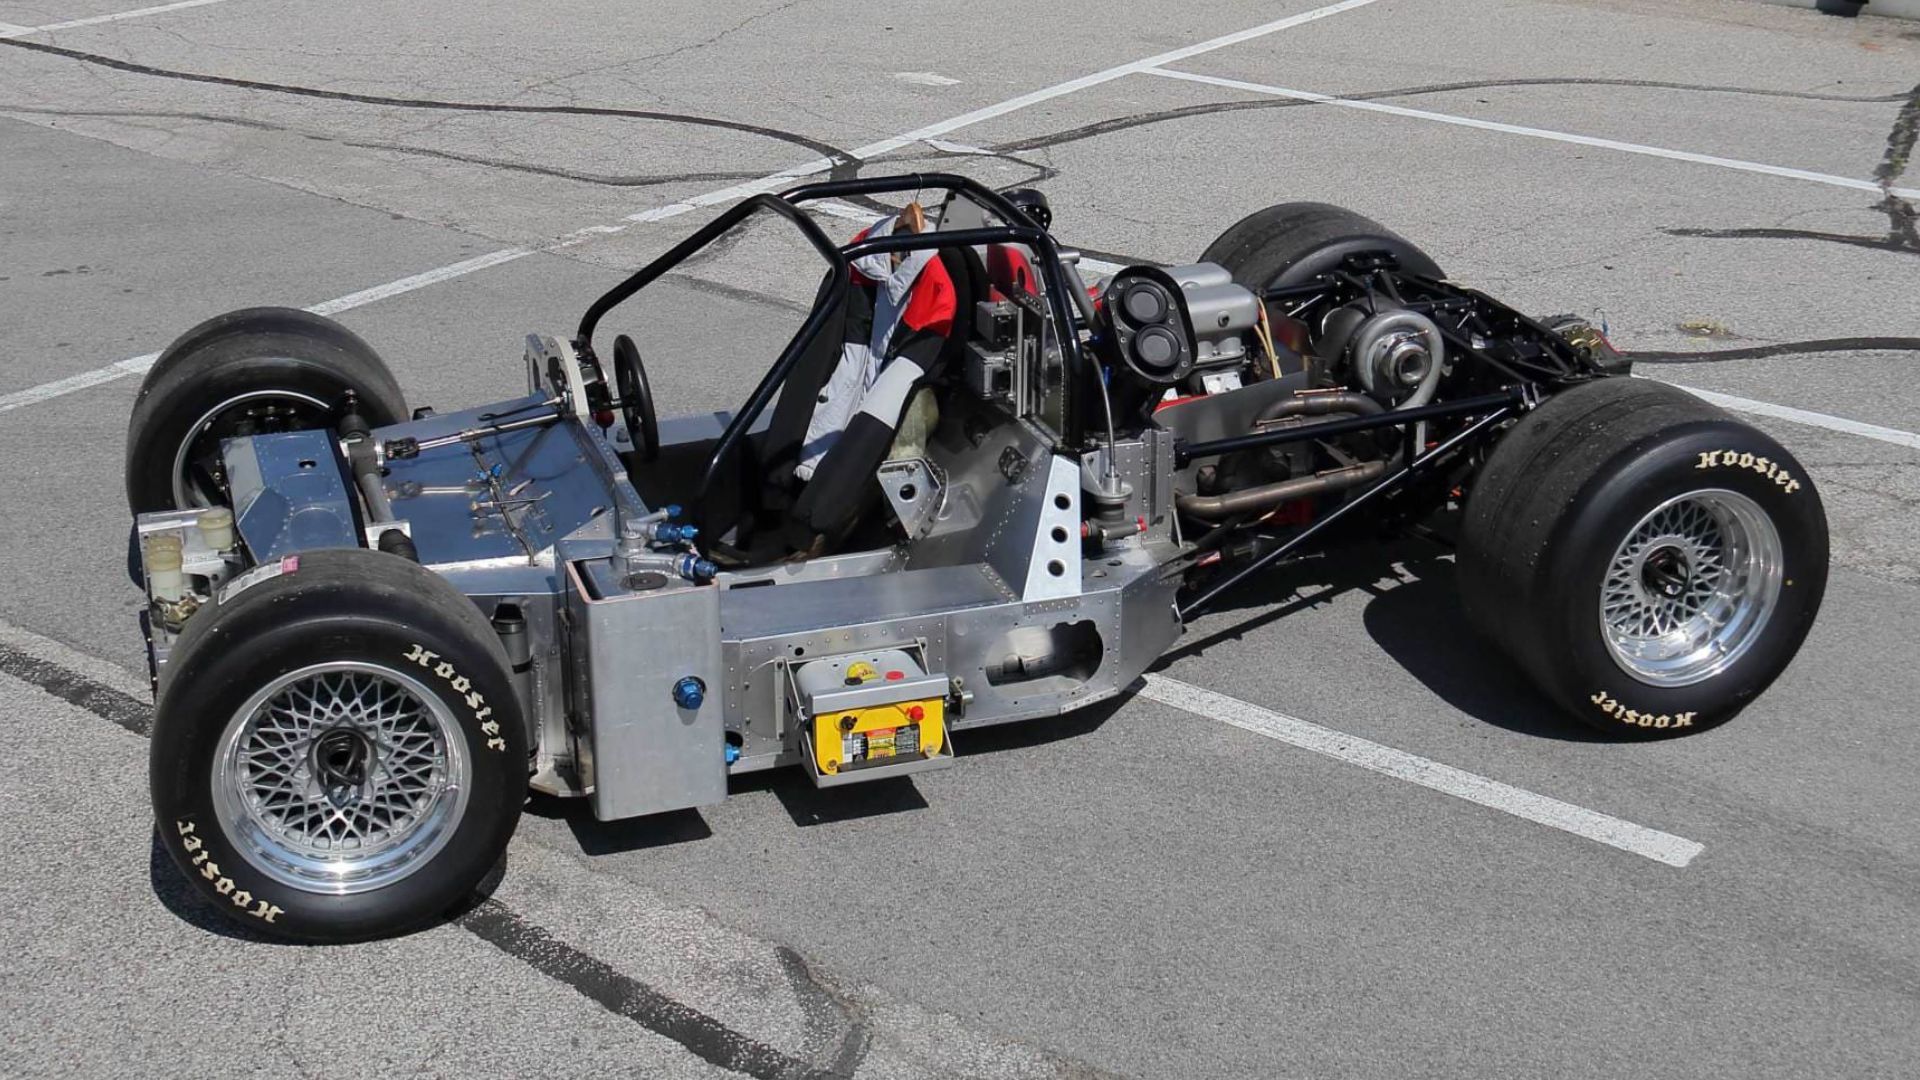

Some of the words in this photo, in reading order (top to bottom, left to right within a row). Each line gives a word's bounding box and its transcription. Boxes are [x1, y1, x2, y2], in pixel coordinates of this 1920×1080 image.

[1694, 450, 1800, 494] Hoosier
[402, 643, 506, 752] Hoosier
[1590, 690, 1699, 729] Hoosier
[177, 820, 285, 923] Hoosier
